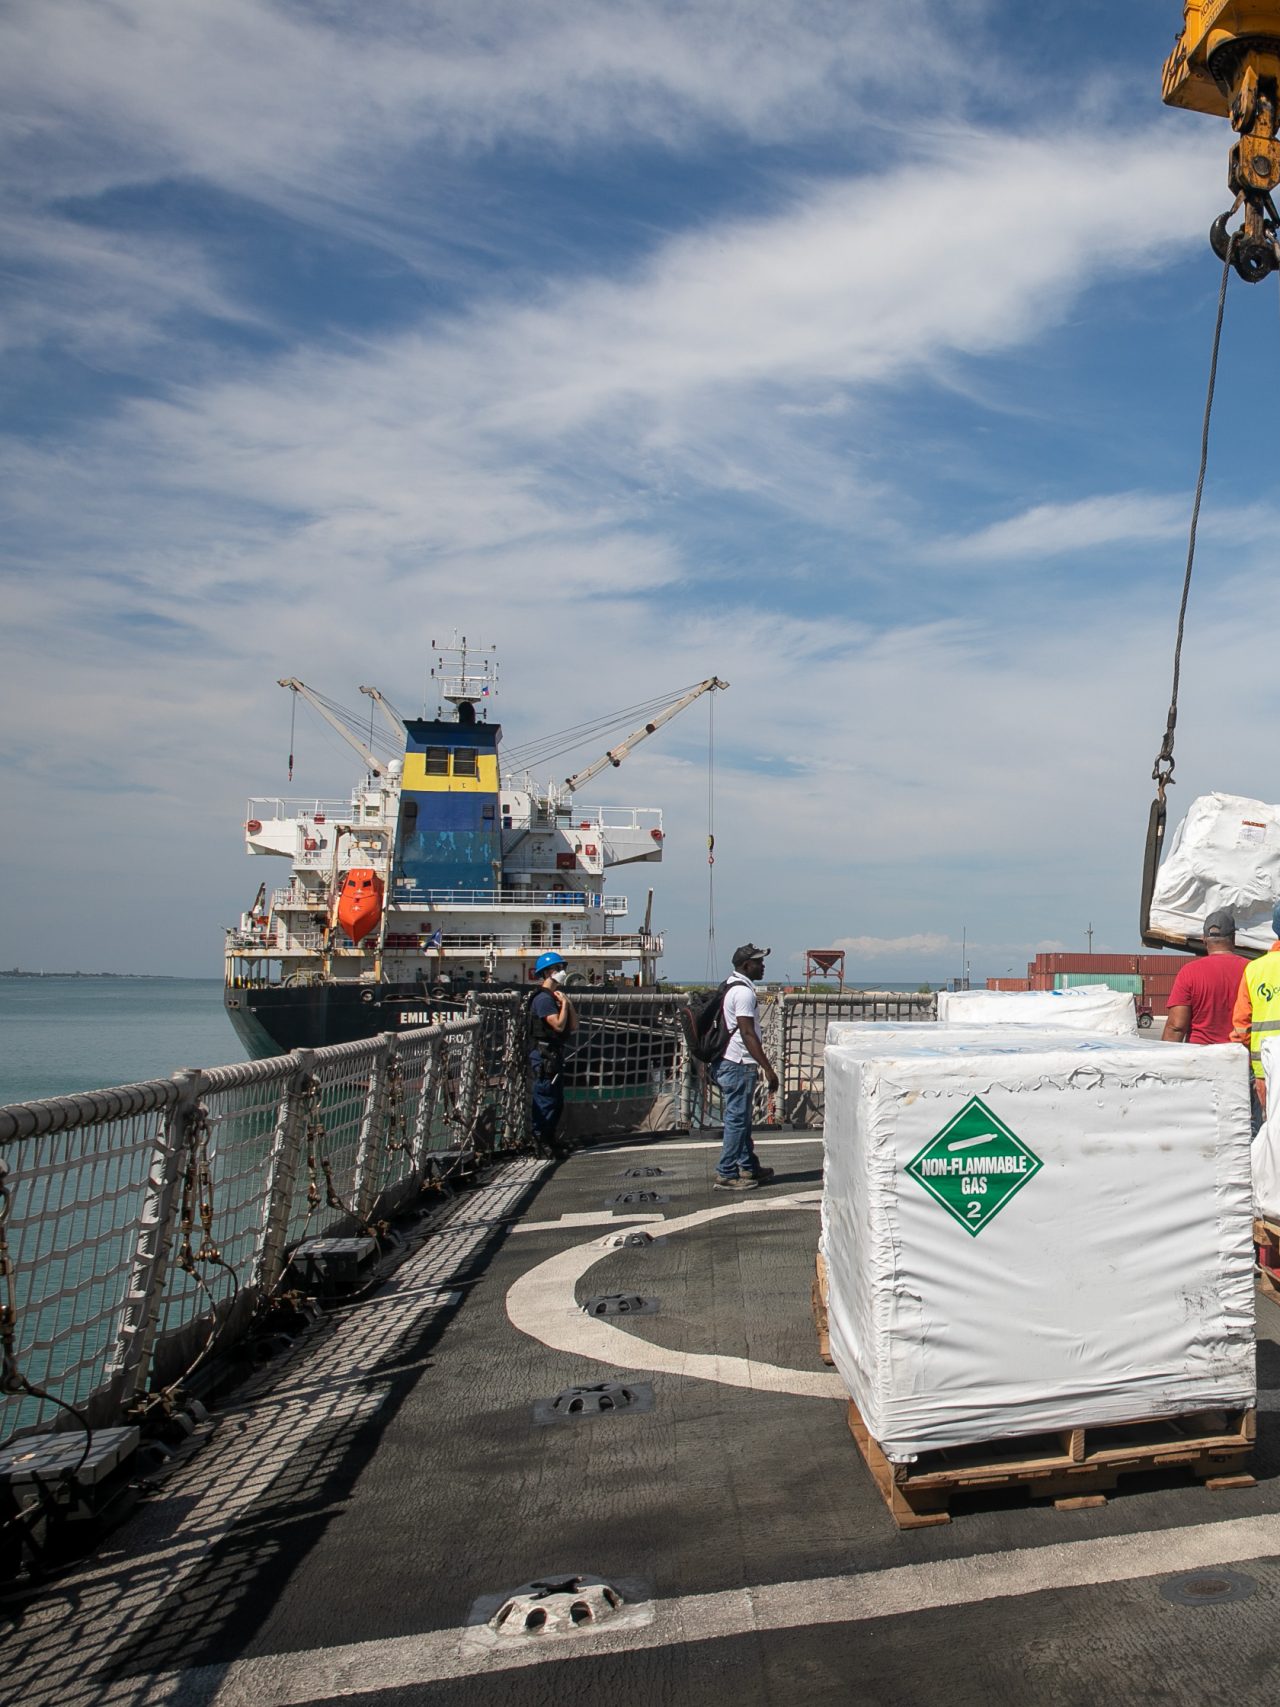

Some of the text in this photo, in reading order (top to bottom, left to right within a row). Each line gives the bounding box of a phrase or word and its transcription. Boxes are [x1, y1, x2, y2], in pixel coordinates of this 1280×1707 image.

[400, 1012, 430, 1024] EMIL
[921, 1155, 1027, 1176] NON-FLAMMABLE
[961, 1176, 988, 1195] GAS
[966, 1201, 982, 1218] 2
